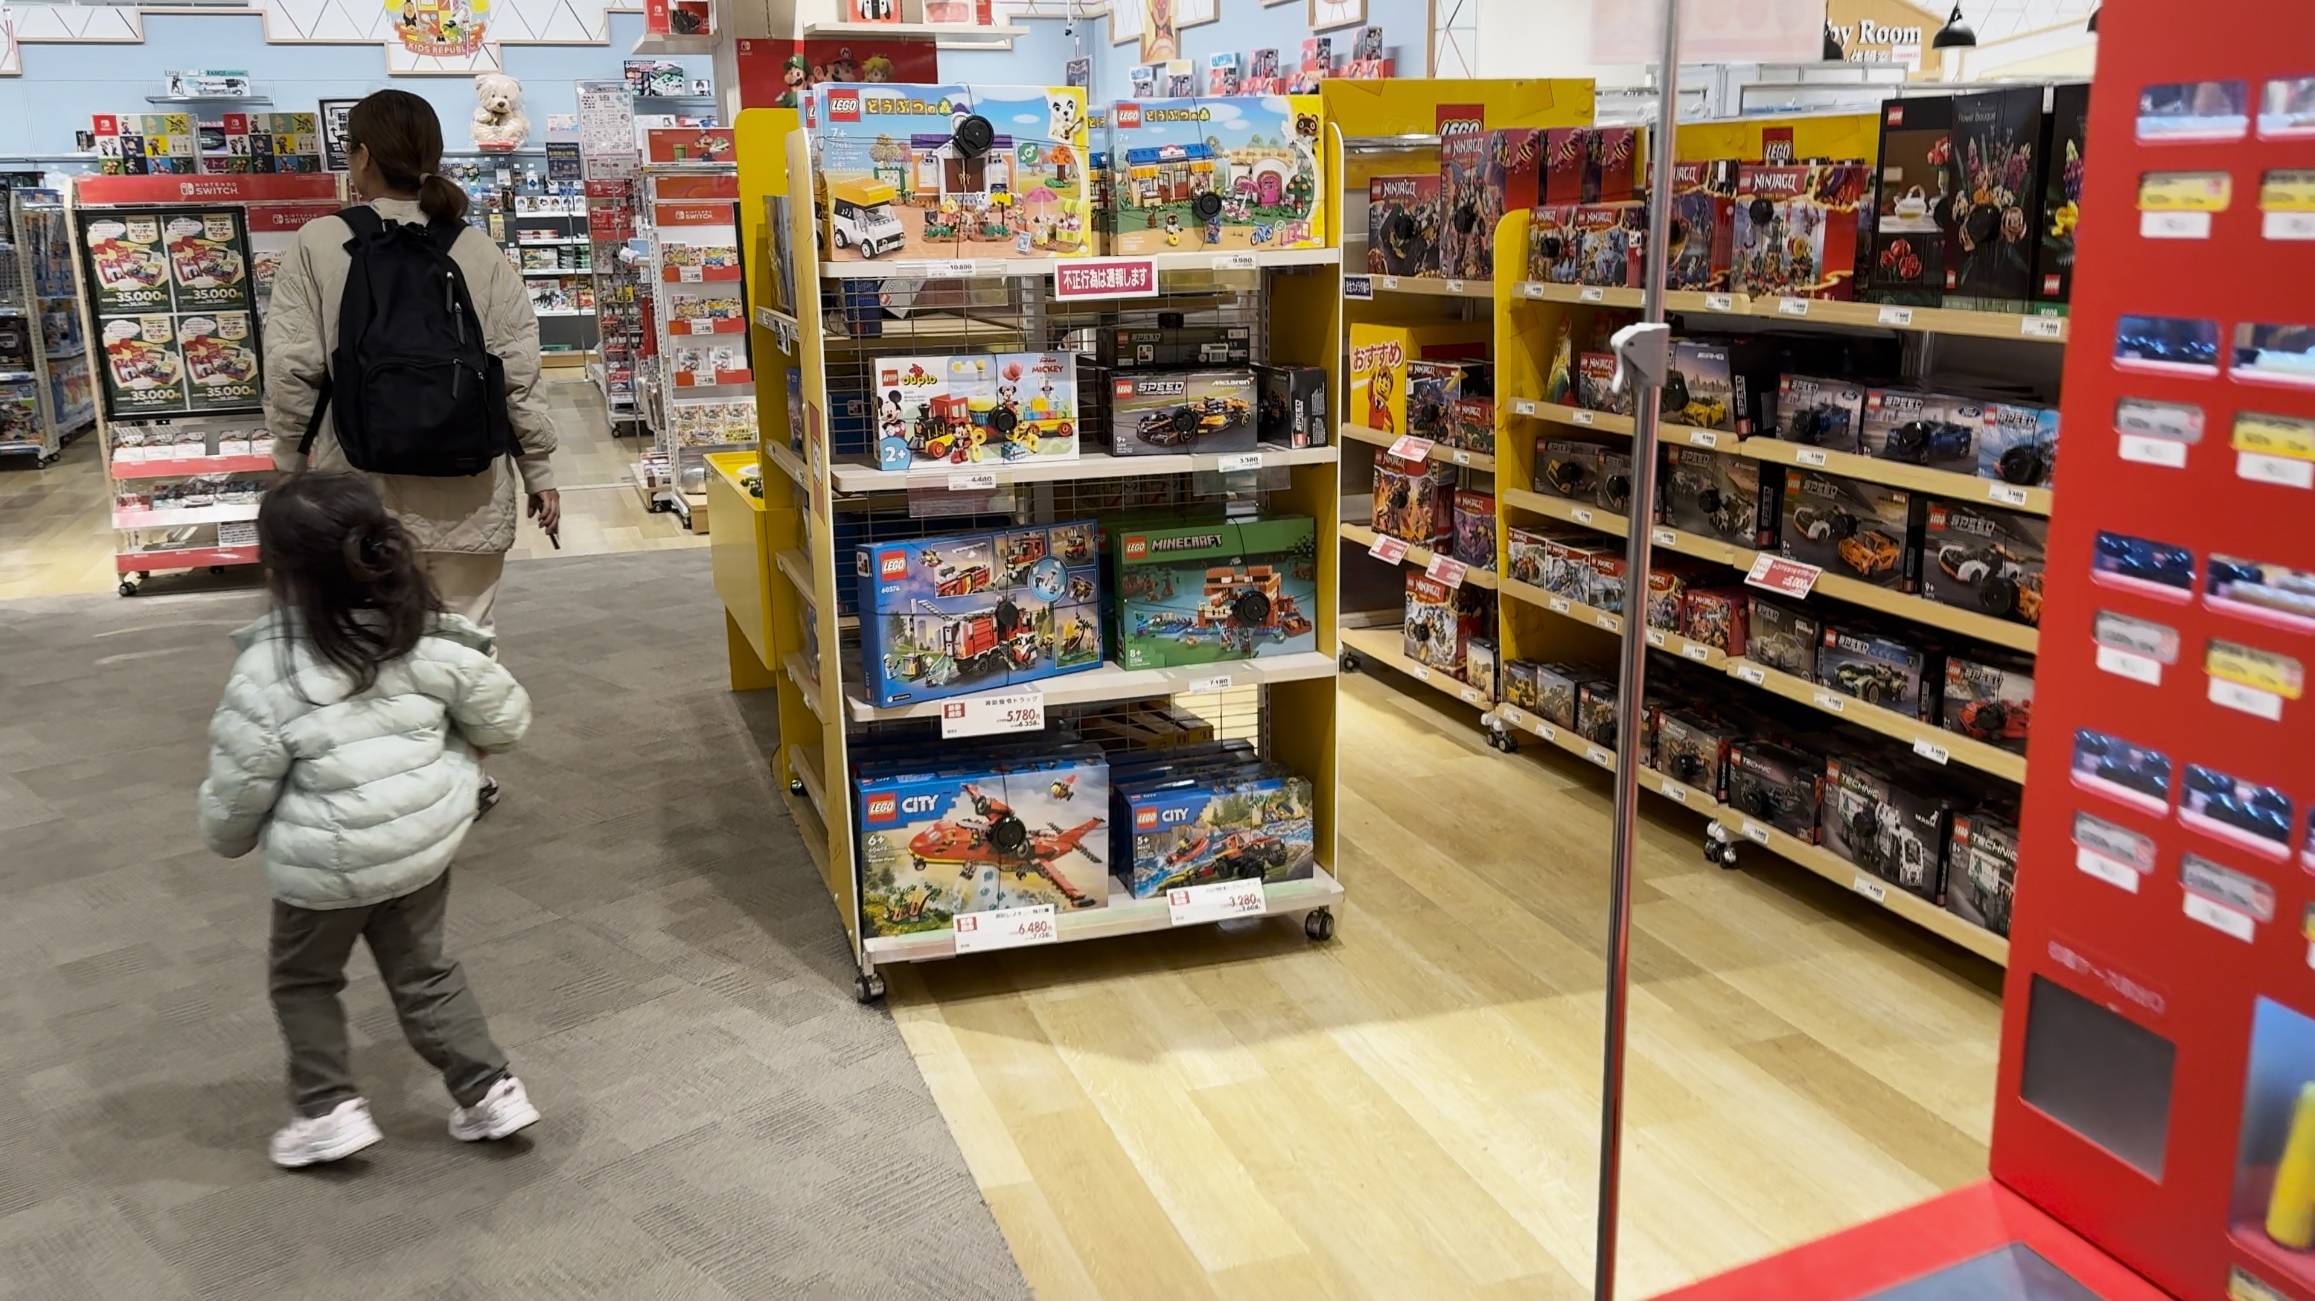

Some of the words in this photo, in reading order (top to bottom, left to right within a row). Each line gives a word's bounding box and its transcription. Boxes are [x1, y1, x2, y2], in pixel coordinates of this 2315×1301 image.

[1859, 20, 1921, 45] Room
[433, 43, 477, 55] REPUBLC
[831, 98, 858, 112] LEGO
[1119, 111, 1138, 121] LEGO
[1439, 119, 1483, 135] LEGO
[1453, 138, 1484, 156] NINJAGO
[1766, 142, 1791, 159] LEGO
[1383, 179, 1416, 198] NINJAGO
[1754, 174, 1797, 192] NINJAGO
[195, 187, 238, 196] SWITCH
[284, 217, 315, 225] SWITC
[1353, 341, 1404, 372] おすすめ
[1032, 365, 1064, 374] MICKEY
[902, 373, 938, 388] duplo
[1138, 381, 1185, 392] SPEED
[1736, 374, 1747, 415] SPEED
[1884, 396, 1924, 409] SPEED
[1999, 412, 2038, 427] SPEED
[886, 447, 906, 462] 2+
[1803, 479, 1838, 499] SPEED
[1951, 514, 1996, 538] SPEED
[1127, 542, 1146, 553] LEGO
[1151, 534, 1223, 551] MINECRAFT
[882, 557, 905, 572] LEGO
[1838, 634, 1869, 655] SPEED
[1964, 666, 2004, 686] SPEED
[1743, 757, 1772, 774] TECHNIC
[1841, 774, 1882, 799] TECHNIC
[868, 801, 895, 814] LEGO
[902, 794, 940, 814] CITY
[1136, 812, 1158, 823] LEGO
[1161, 807, 1190, 822] CITY
[868, 834, 885, 846] 6+
[1137, 836, 1150, 845] 5+
[1972, 831, 2018, 861] TECHNIC
